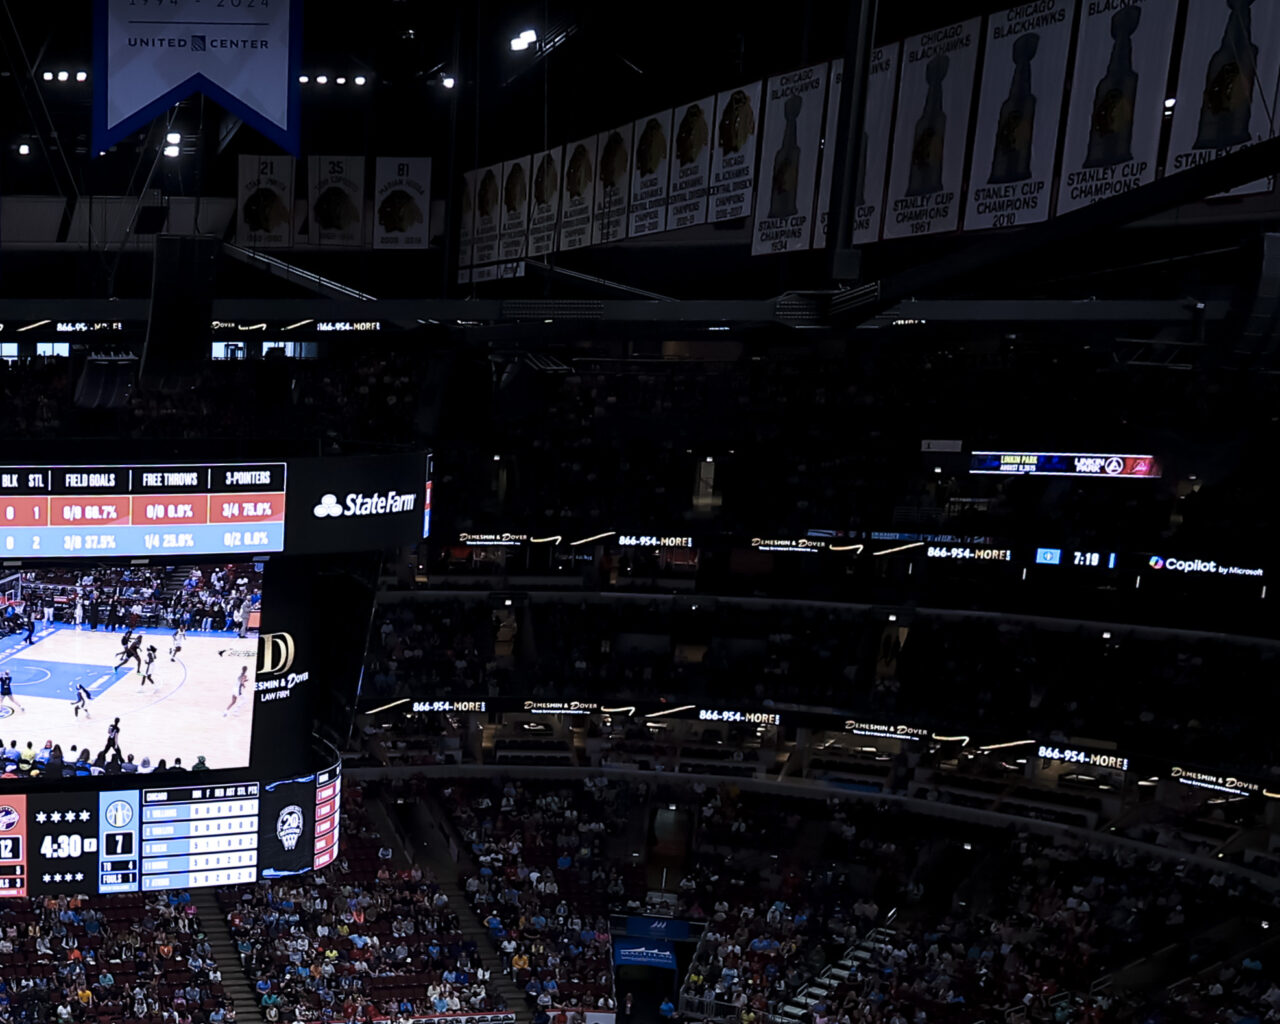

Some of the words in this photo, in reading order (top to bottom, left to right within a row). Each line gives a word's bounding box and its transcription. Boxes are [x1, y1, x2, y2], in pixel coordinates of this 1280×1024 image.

[1007, 0, 1055, 22] CHICAGO
[993, 12, 1065, 39] BLACKHAWKS
[128, 38, 187, 48] UNITED
[210, 39, 269, 49] CENTER
[921, 25, 963, 47] CHICAGO
[909, 35, 971, 62] BLACKHAWKS
[780, 69, 813, 86] CHICAGO
[771, 79, 820, 100] BLACKHAWKS
[260, 161, 274, 175] 21
[328, 161, 344, 175] 35
[1068, 167, 1118, 186] STANLEY
[1122, 162, 1148, 177] CUP
[975, 185, 1018, 201] STANLEY
[1021, 182, 1044, 195] CUP
[1071, 178, 1141, 200] CHAMPIONS
[893, 196, 932, 212] STANLEY
[935, 193, 954, 206] CUP
[976, 197, 1038, 214] CHAMPIONS
[895, 206, 949, 223] CHAMPIONS
[993, 213, 1016, 227] 2010
[758, 218, 789, 232] STANLEY
[790, 216, 807, 228] CUP
[910, 222, 931, 234] 1961
[760, 228, 802, 242] CHAMPIONS
[2, 474, 18, 488] BLK
[28, 474, 44, 488] STL
[65, 474, 88, 487] FIELD
[89, 473, 116, 487] GOALS
[142, 473, 163, 486] FREE
[164, 472, 198, 486] THROWS
[225, 471, 271, 485] 3-POINTERS
[33, 506, 40, 519] 1
[32, 536, 40, 549] 2
[619, 536, 687, 547] 866-954-MORE
[927, 547, 1006, 560] 866-954-MORE
[1165, 557, 1217, 572] Copilot
[1218, 566, 1228, 574] by
[1228, 566, 1264, 577] Microsoft
[261, 691, 276, 702] LAW
[412, 701, 481, 712] 866-954-MORE
[698, 709, 775, 725] 866-954-MORE
[1038, 746, 1123, 769] 866-954-MORE
[1225, 777, 1259, 791] DOVER
[0, 839, 12, 858] 12
[40, 834, 81, 858] 4:30
[115, 835, 123, 853] 7
